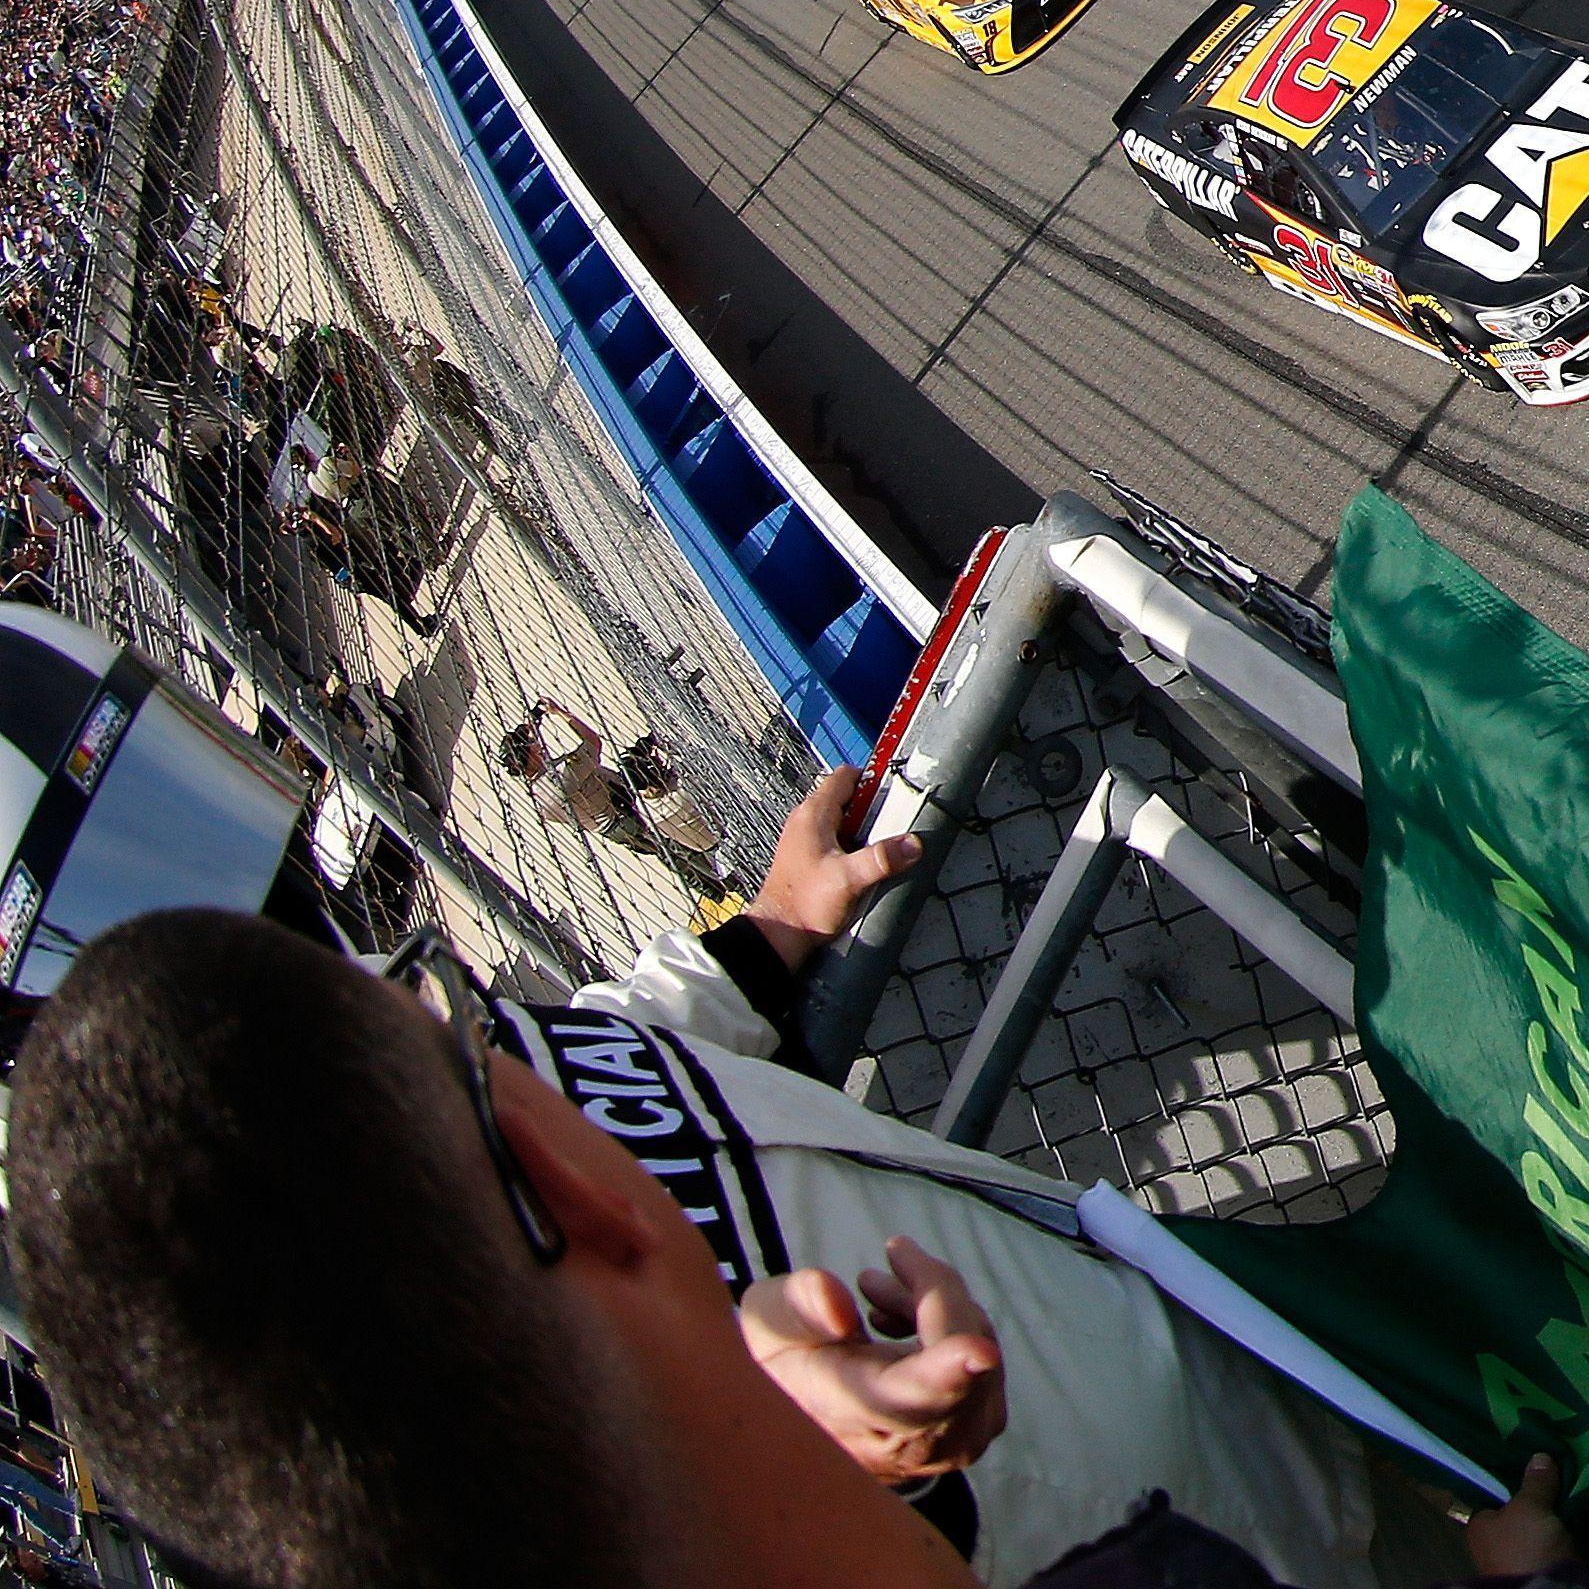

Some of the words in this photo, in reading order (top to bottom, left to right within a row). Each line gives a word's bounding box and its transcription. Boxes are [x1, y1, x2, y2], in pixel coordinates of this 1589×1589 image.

[1353, 45, 1418, 114] NEWMAN
[1121, 128, 1242, 222] CATERPILLAR
[1273, 224, 1360, 309] 31
